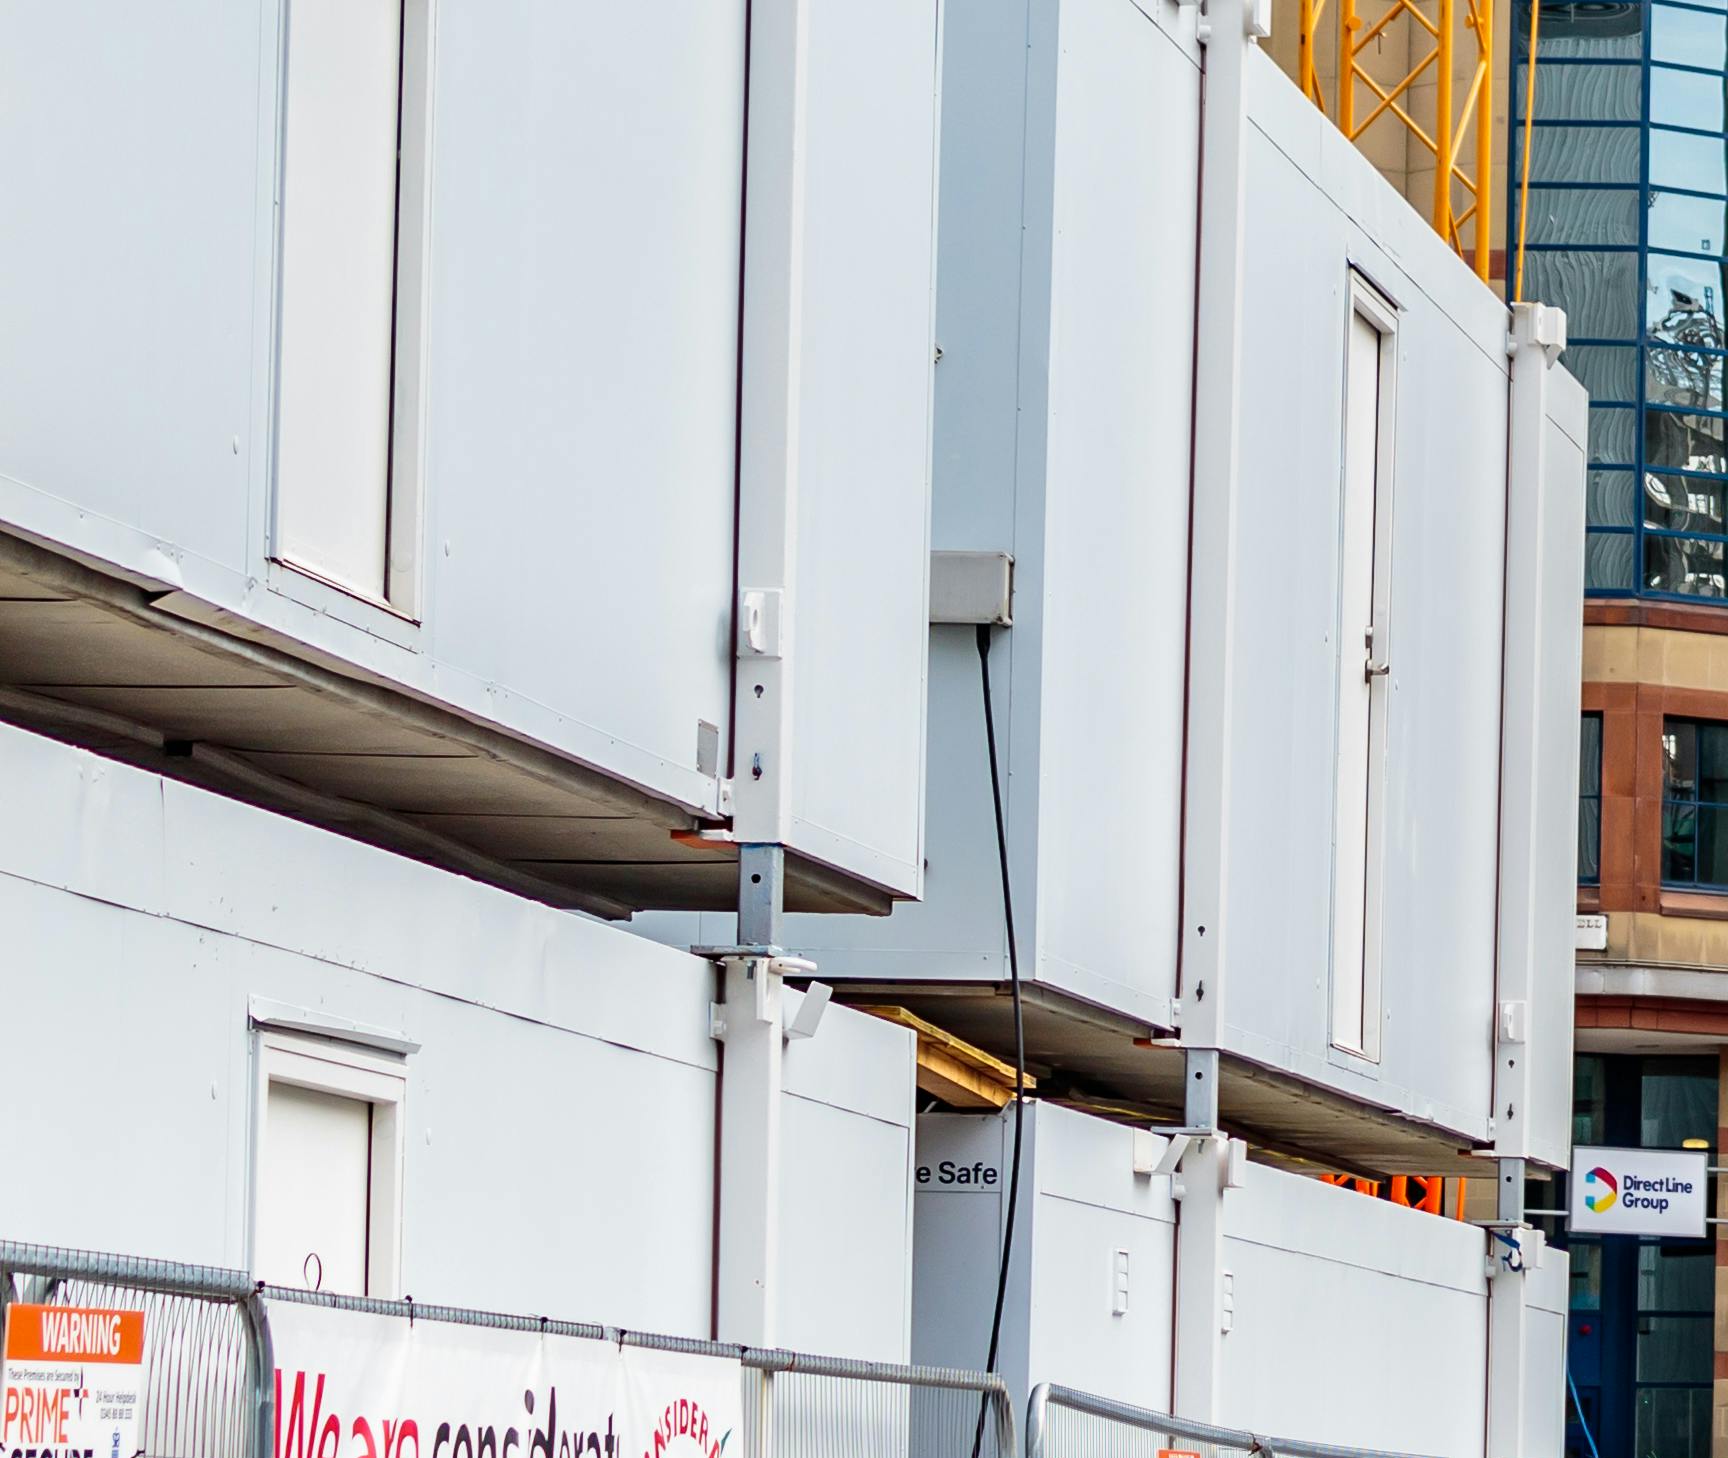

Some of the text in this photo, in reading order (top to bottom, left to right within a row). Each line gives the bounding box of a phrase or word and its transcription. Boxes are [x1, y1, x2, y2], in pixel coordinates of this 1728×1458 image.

[938, 1161, 998, 1184] Safe
[1623, 1175, 1693, 1194] Direct Line
[1622, 1192, 1669, 1214] Group
[42, 1311, 122, 1356] WARNING
[4, 1387, 72, 1444] PRIME
